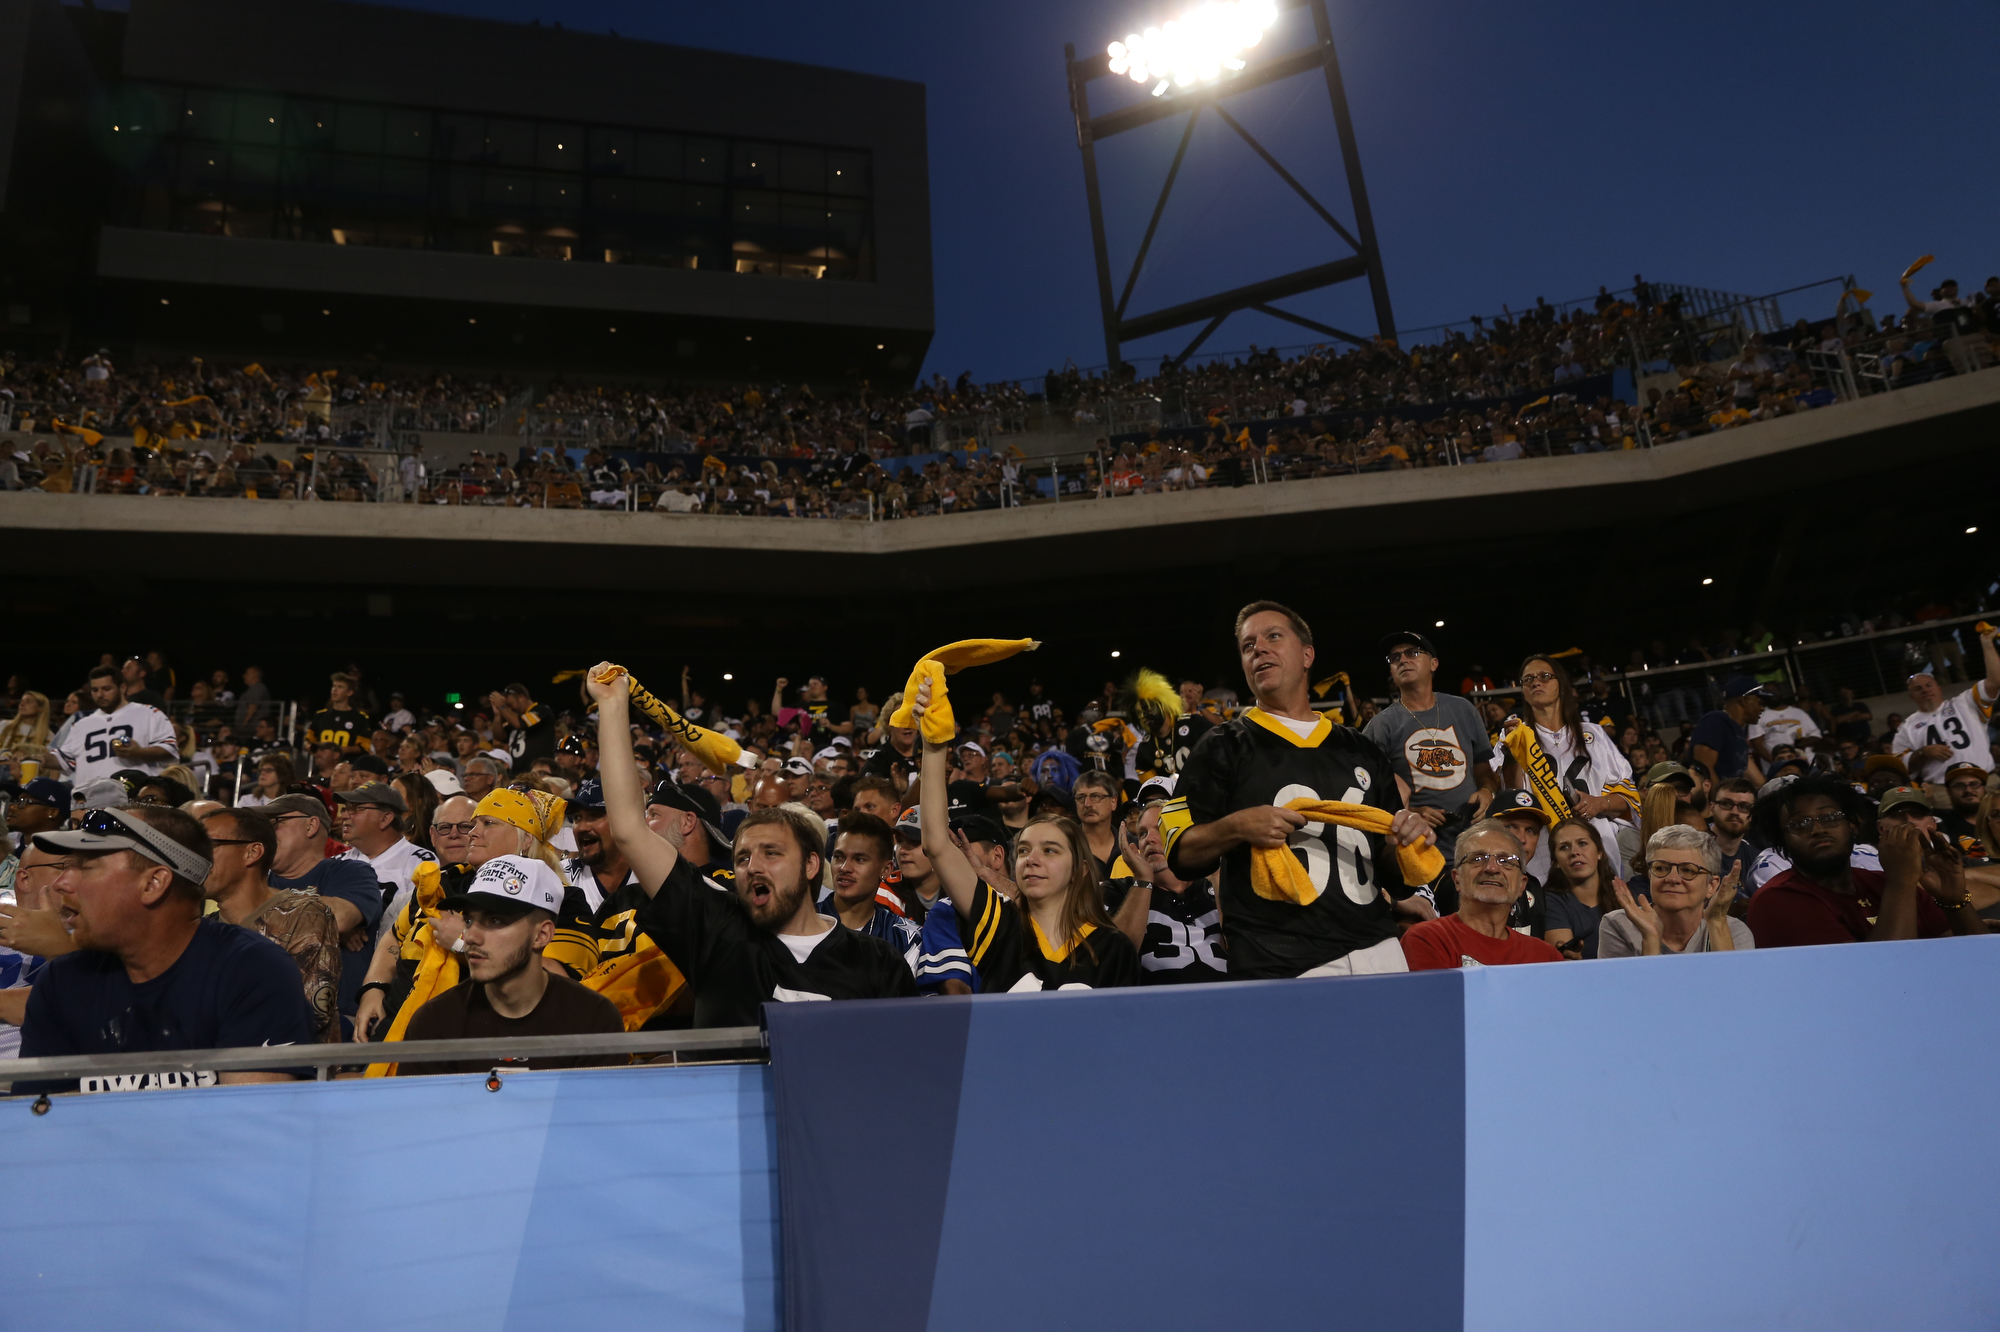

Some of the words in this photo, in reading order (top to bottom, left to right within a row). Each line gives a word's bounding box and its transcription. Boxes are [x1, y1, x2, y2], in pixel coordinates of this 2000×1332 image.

[1926, 716, 1971, 750] 43
[1273, 783, 1378, 906] 36
[480, 869, 506, 880] GAME
[501, 864, 529, 884] FAME
